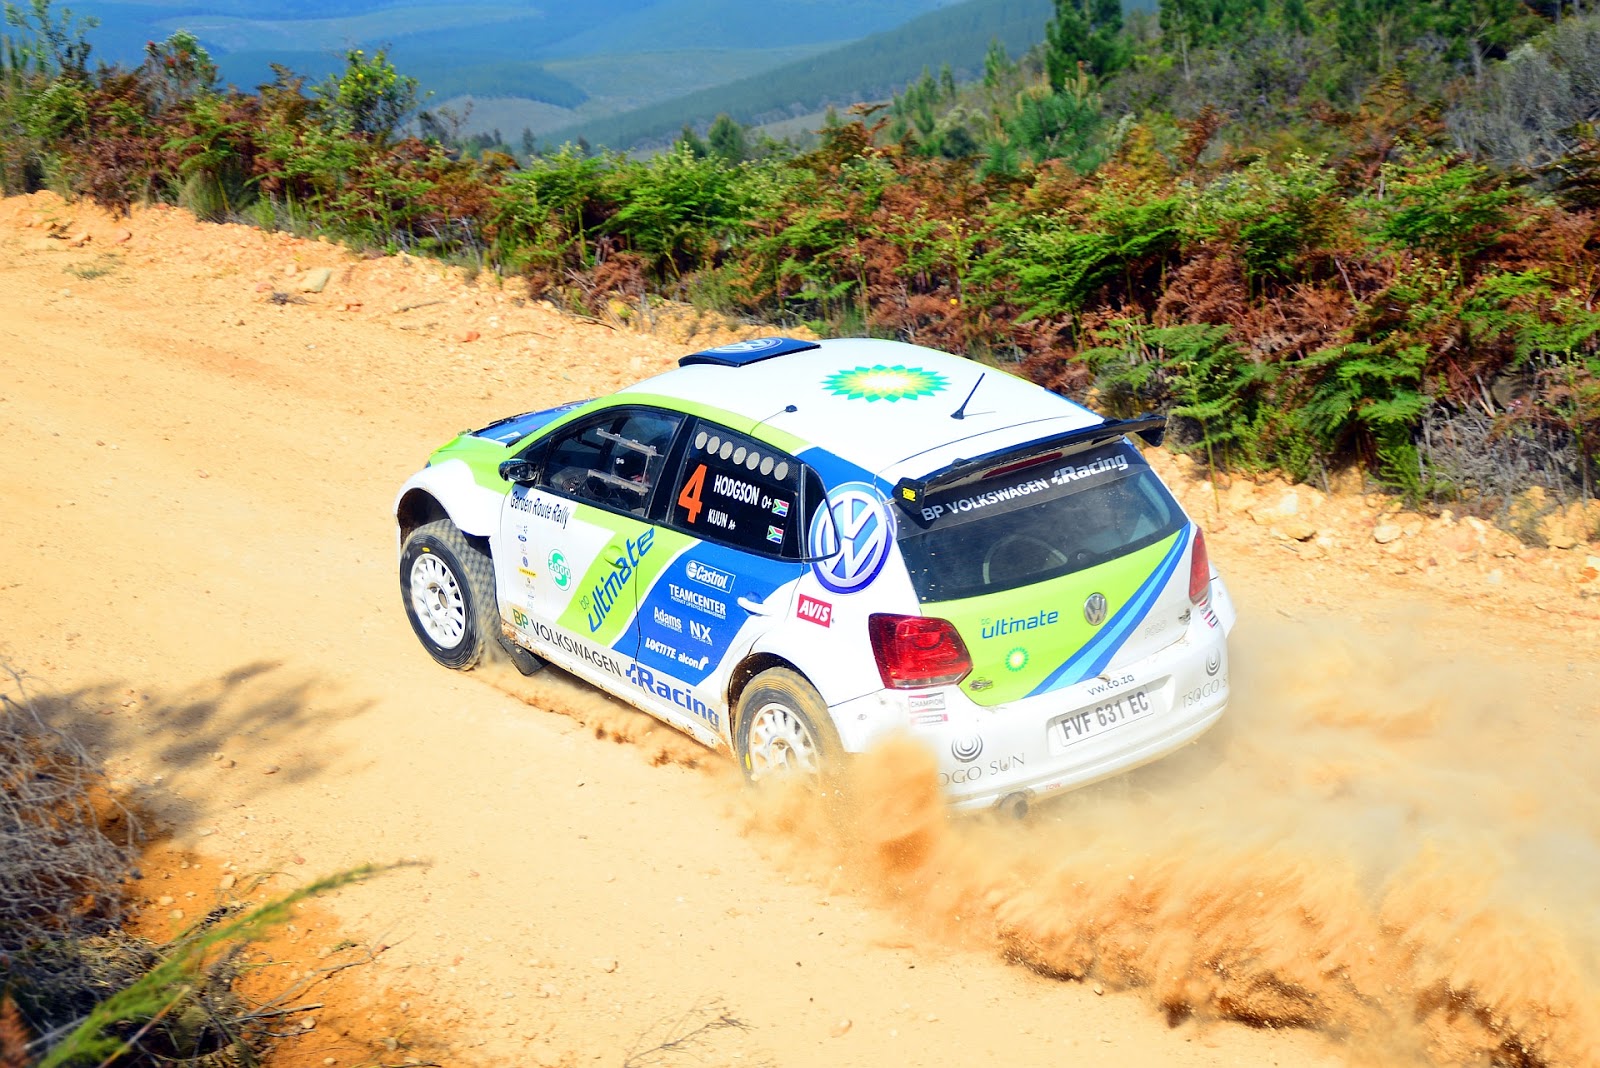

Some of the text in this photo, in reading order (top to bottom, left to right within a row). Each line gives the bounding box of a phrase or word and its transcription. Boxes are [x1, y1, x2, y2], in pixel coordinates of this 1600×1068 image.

[678, 463, 708, 524] 4
[713, 474, 761, 506] HODGSON
[920, 503, 944, 521] BP
[948, 478, 1050, 514] VOLKSWAGEN
[1056, 453, 1129, 484] Racing
[510, 490, 570, 530] Garden Route Rally
[707, 508, 728, 528] KUUN
[548, 560, 571, 579] 2000
[588, 527, 655, 633] ultimate
[696, 565, 729, 589] Castrol
[668, 583, 727, 616] TEAMCENTER
[798, 600, 831, 622] AVIS
[654, 606, 682, 629] Adams
[981, 609, 1059, 639] ultimate
[689, 620, 712, 643] NX
[644, 637, 676, 660] LOCTITE
[678, 652, 700, 670] alcon
[512, 608, 720, 733] BP VOLKSWAGEN Racing
[1087, 673, 1135, 696] vw.co.za
[910, 697, 945, 709] CHAMPION
[1061, 691, 1149, 740] FVF 631 EC
[934, 752, 1025, 787] OGO SUN
